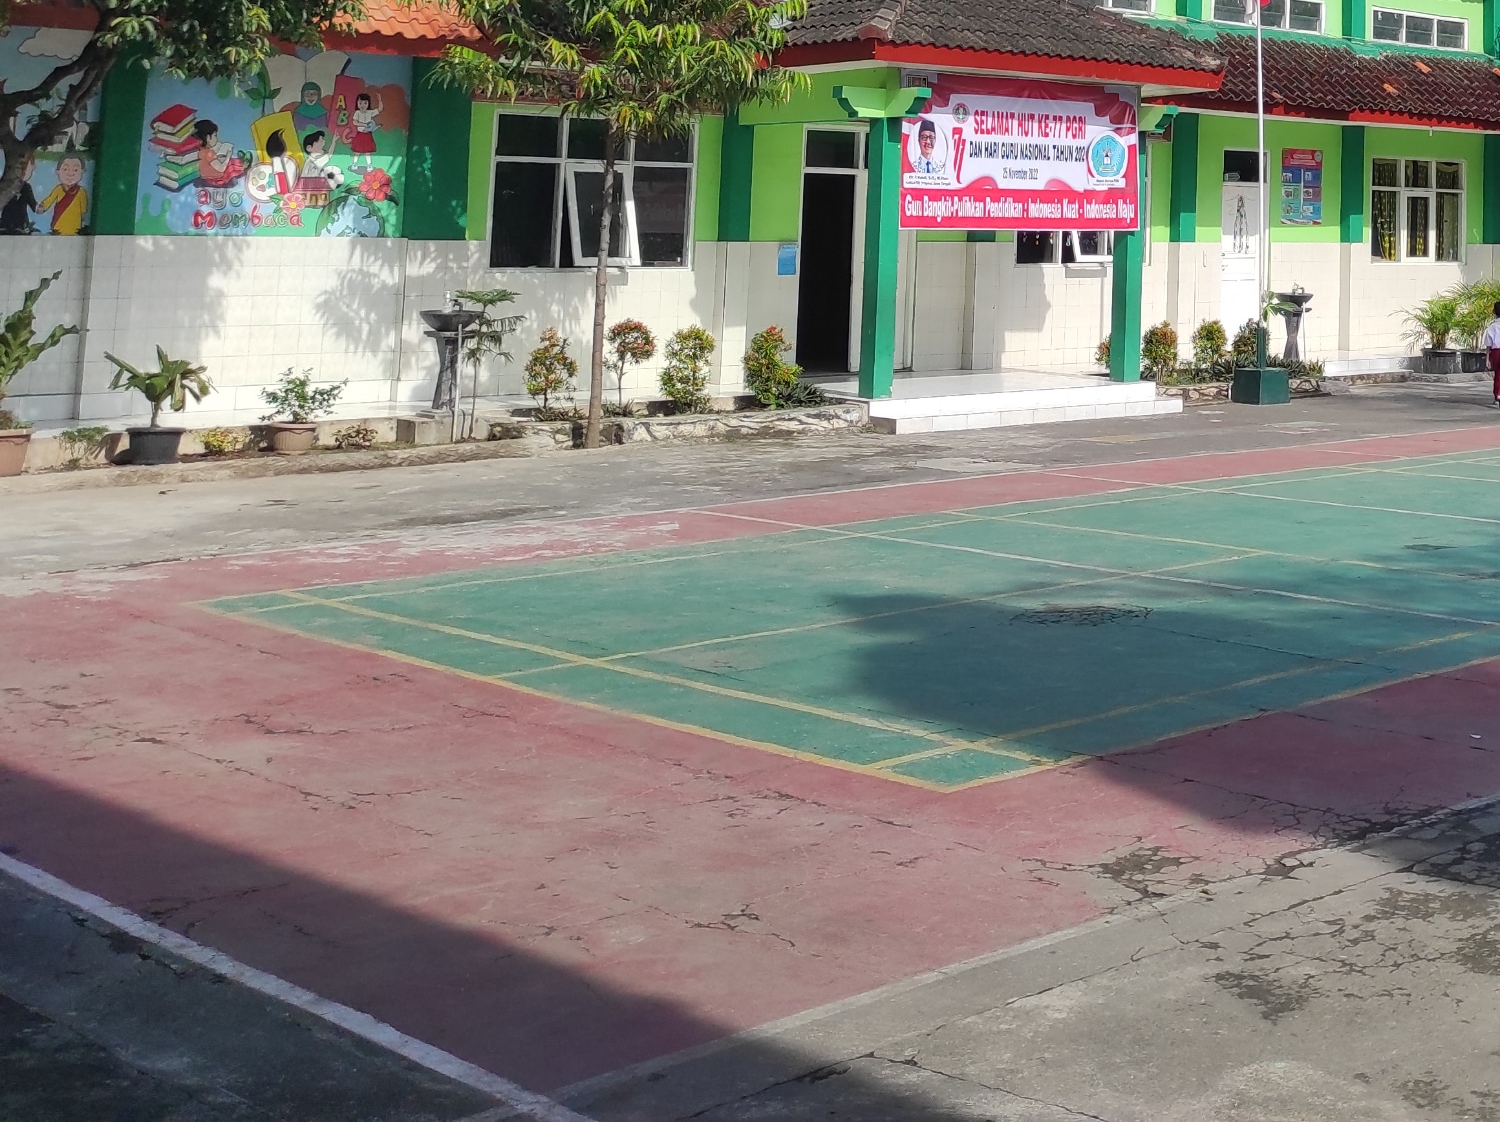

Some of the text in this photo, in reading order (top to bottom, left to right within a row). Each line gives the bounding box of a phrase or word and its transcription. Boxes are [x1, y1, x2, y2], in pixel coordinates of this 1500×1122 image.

[973, 109, 1087, 140] SELAMAT HUT KE-77 PGRI
[969, 140, 983, 159] DAN
[984, 141, 1000, 159] HARI
[1001, 142, 1019, 161] GURU
[1020, 143, 1051, 162] NASIONAL
[1052, 144, 1074, 163] TAHUN
[1002, 167, 1039, 181] 25 November 2022
[197, 188, 244, 210] ayo
[904, 194, 923, 217] Guru
[985, 196, 1023, 218] Pendidikan
[1028, 197, 1062, 218] Indonesia
[1062, 198, 1079, 219] Kuat
[1084, 198, 1116, 219] Indonesia
[1118, 198, 1135, 224] Maju
